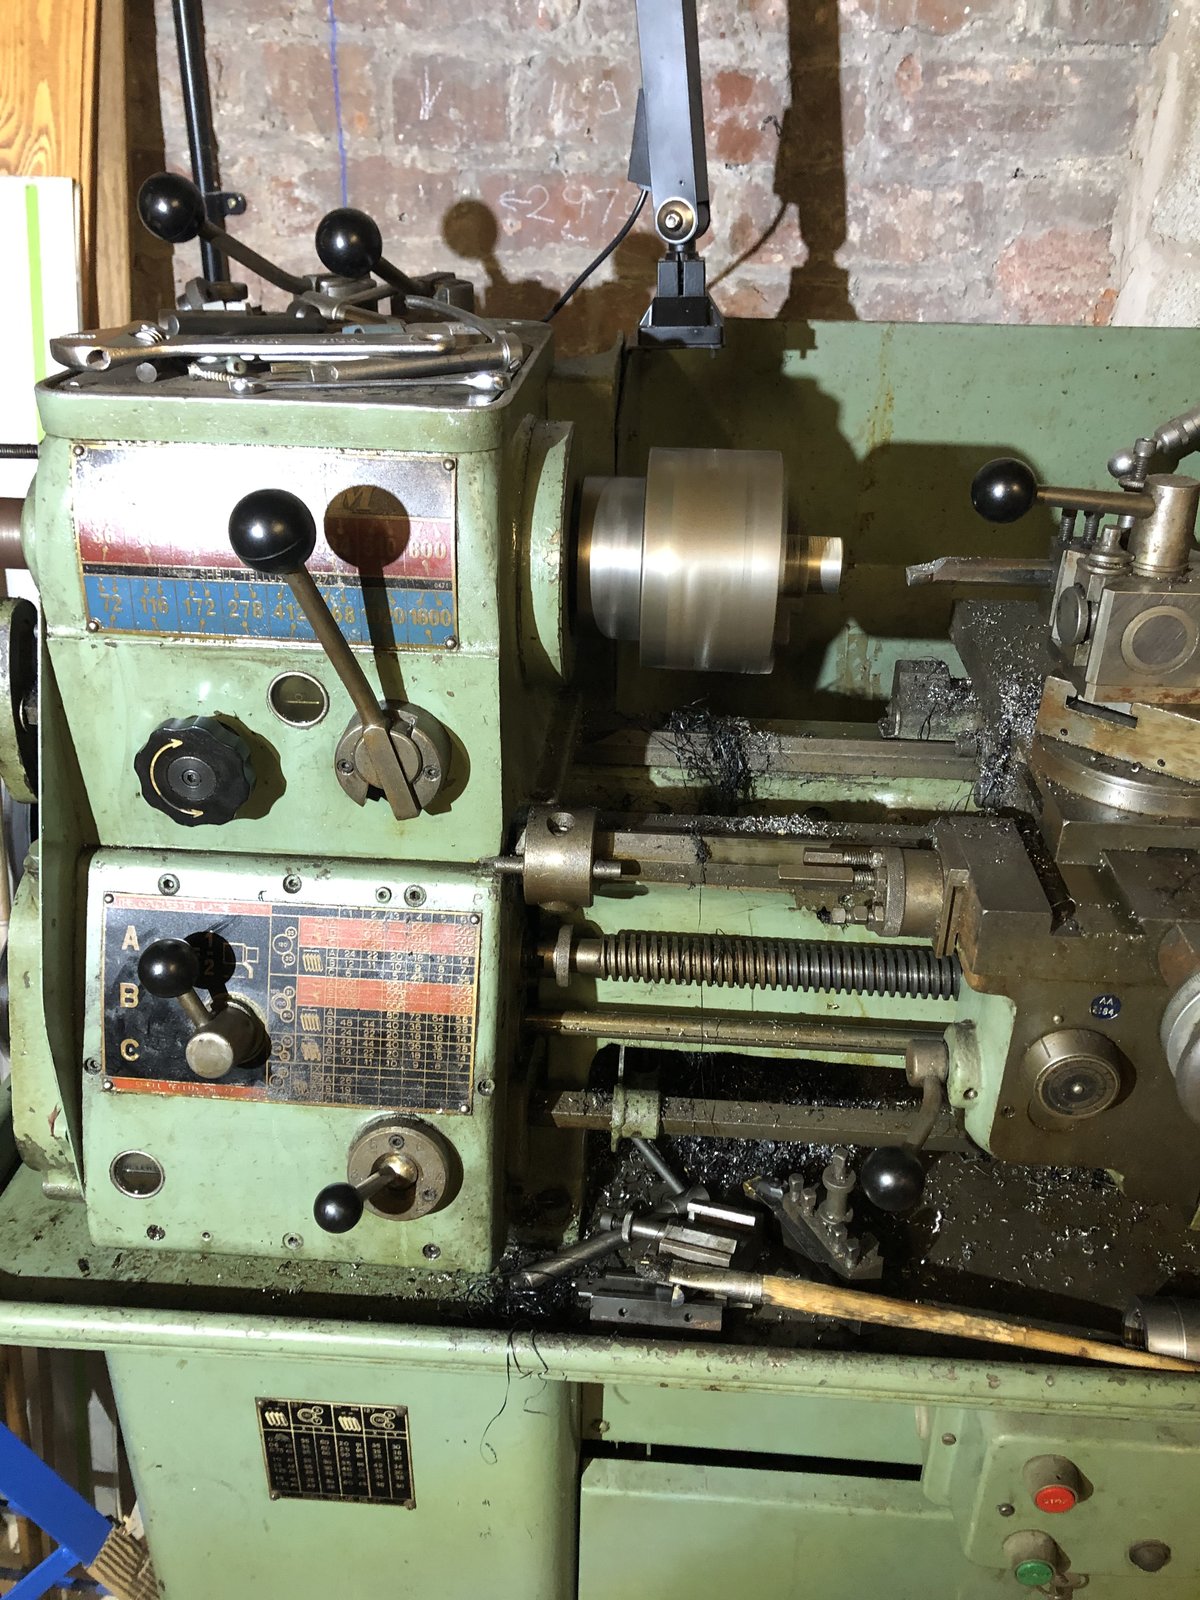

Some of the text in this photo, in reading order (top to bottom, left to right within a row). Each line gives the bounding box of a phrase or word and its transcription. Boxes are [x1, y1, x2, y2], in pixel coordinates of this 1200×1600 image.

[408, 539, 447, 559] 800
[200, 569, 234, 581] SHELL
[241, 570, 284, 582] TELLUS
[99, 593, 122, 613] 72
[141, 595, 168, 614] 116
[185, 597, 216, 616] 172
[228, 599, 263, 618] 278
[409, 607, 451, 627] 1600
[348, 910, 353, 918] 1
[371, 911, 377, 919] 2
[394, 912, 400, 920] 3
[121, 925, 140, 951] A
[344, 950, 355, 958] 24
[367, 951, 379, 959] 22
[390, 952, 403, 960] 20
[414, 954, 424, 962] 18
[437, 955, 447, 963] 16
[459, 957, 470, 965] 14
[204, 958, 215, 976] 2
[367, 961, 376, 969] 11
[391, 962, 402, 971] 10
[460, 967, 467, 976] 7
[392, 972, 399, 980] 5
[120, 983, 139, 1008] B
[327, 1008, 334, 1016] A
[409, 1013, 421, 1021] 72
[456, 1016, 468, 1024] 56
[340, 1019, 353, 1027] 48
[363, 1020, 375, 1028] 44
[386, 1021, 399, 1029] 40
[410, 1023, 422, 1031] 36
[432, 1024, 444, 1032] 32
[456, 1026, 468, 1034] 28
[386, 1031, 399, 1039] 20
[433, 1034, 444, 1042] 16
[120, 1038, 140, 1061] C
[385, 1041, 399, 1049] 40
[410, 1043, 421, 1051] 36
[455, 1045, 468, 1053] 28
[340, 1048, 352, 1056] 24
[363, 1049, 375, 1057] 22
[386, 1050, 399, 1058] 20
[411, 1052, 421, 1060] 18
[456, 1054, 466, 1062] 14
[341, 1057, 352, 1065] 12
[386, 1060, 398, 1068] 10
